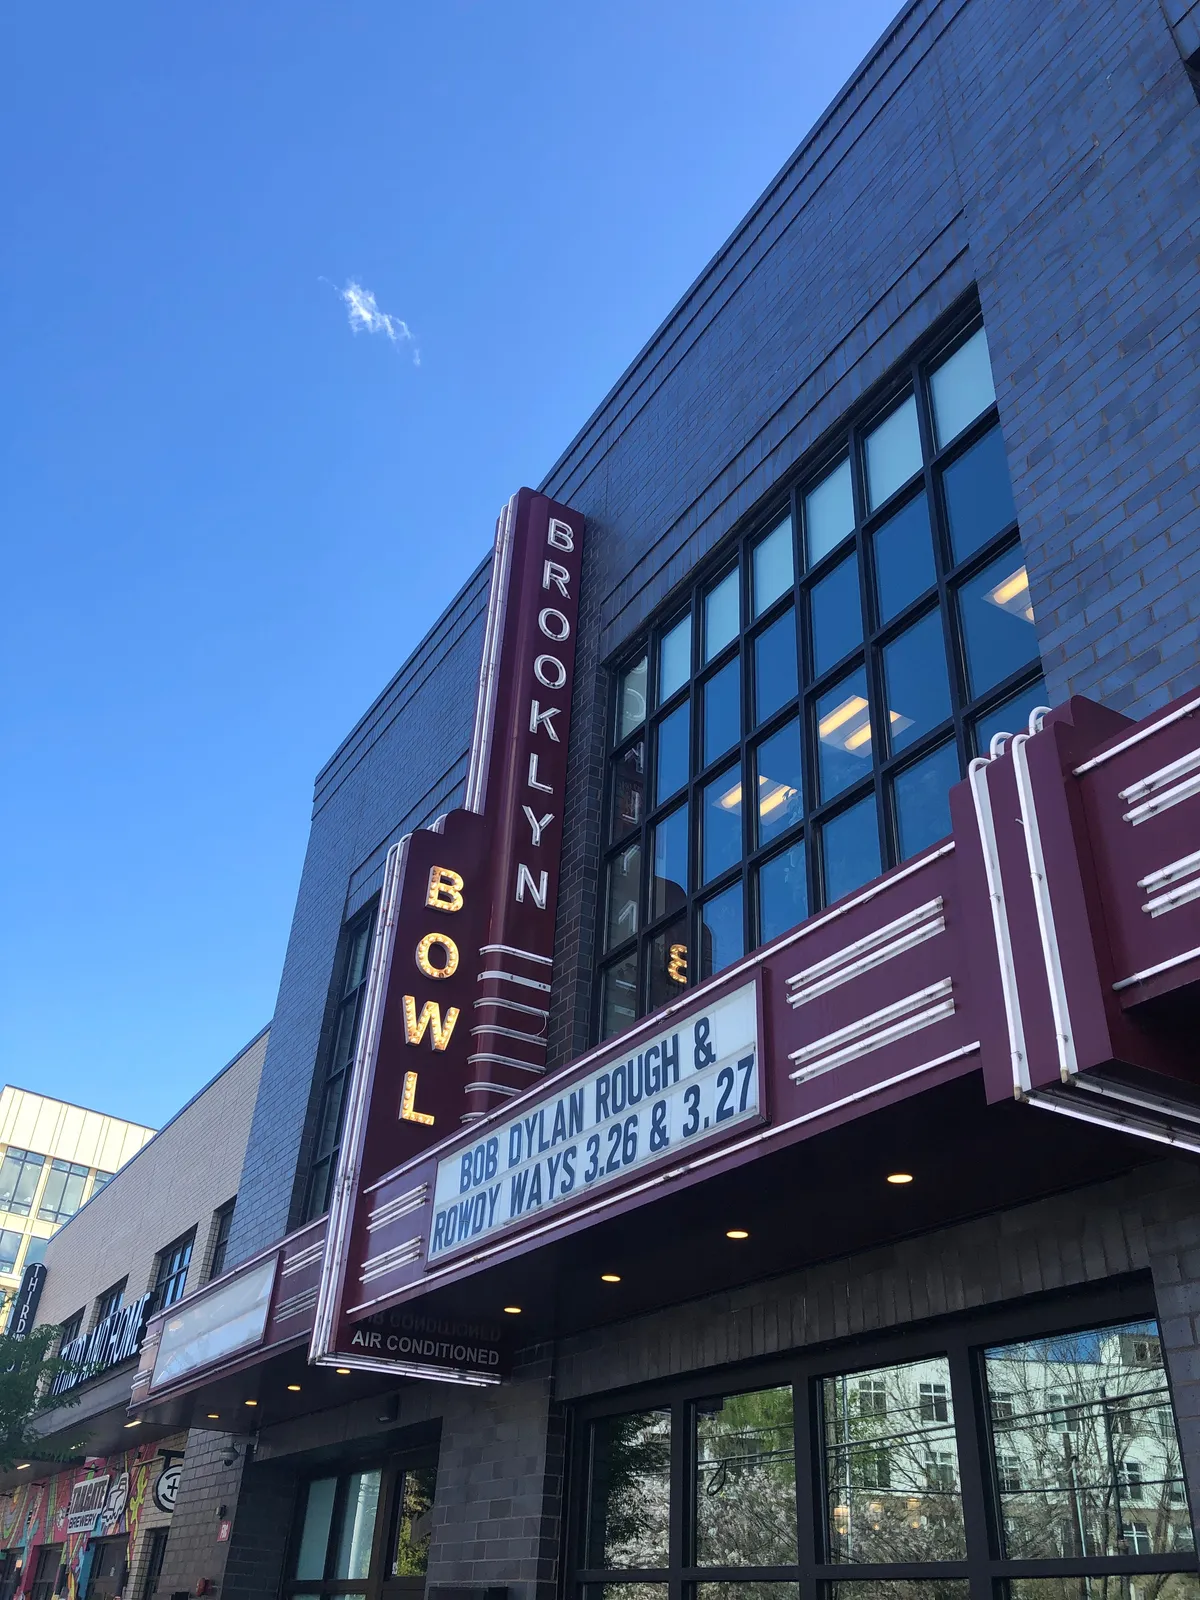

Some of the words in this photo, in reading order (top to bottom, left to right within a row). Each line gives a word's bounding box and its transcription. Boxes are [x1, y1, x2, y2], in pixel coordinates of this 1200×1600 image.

[515, 517, 575, 910] BROOKLYN
[398, 865, 465, 1126] BOWL
[460, 1137, 499, 1195] BOB
[508, 1087, 584, 1169] DYLAN
[595, 1033, 680, 1125] ROUGH
[694, 1016, 716, 1071] &
[431, 1182, 502, 1254] ROWDY
[509, 1144, 577, 1218] WAYS
[584, 1114, 639, 1183] 3.26
[649, 1099, 670, 1153] &
[17, 1263, 43, 1333] THIRD
[103, 1292, 151, 1366] HOME
[351, 1329, 382, 1349] AIR
[386, 1334, 500, 1366] CONDITIONED
[68, 1512, 97, 1529] BREWERY
